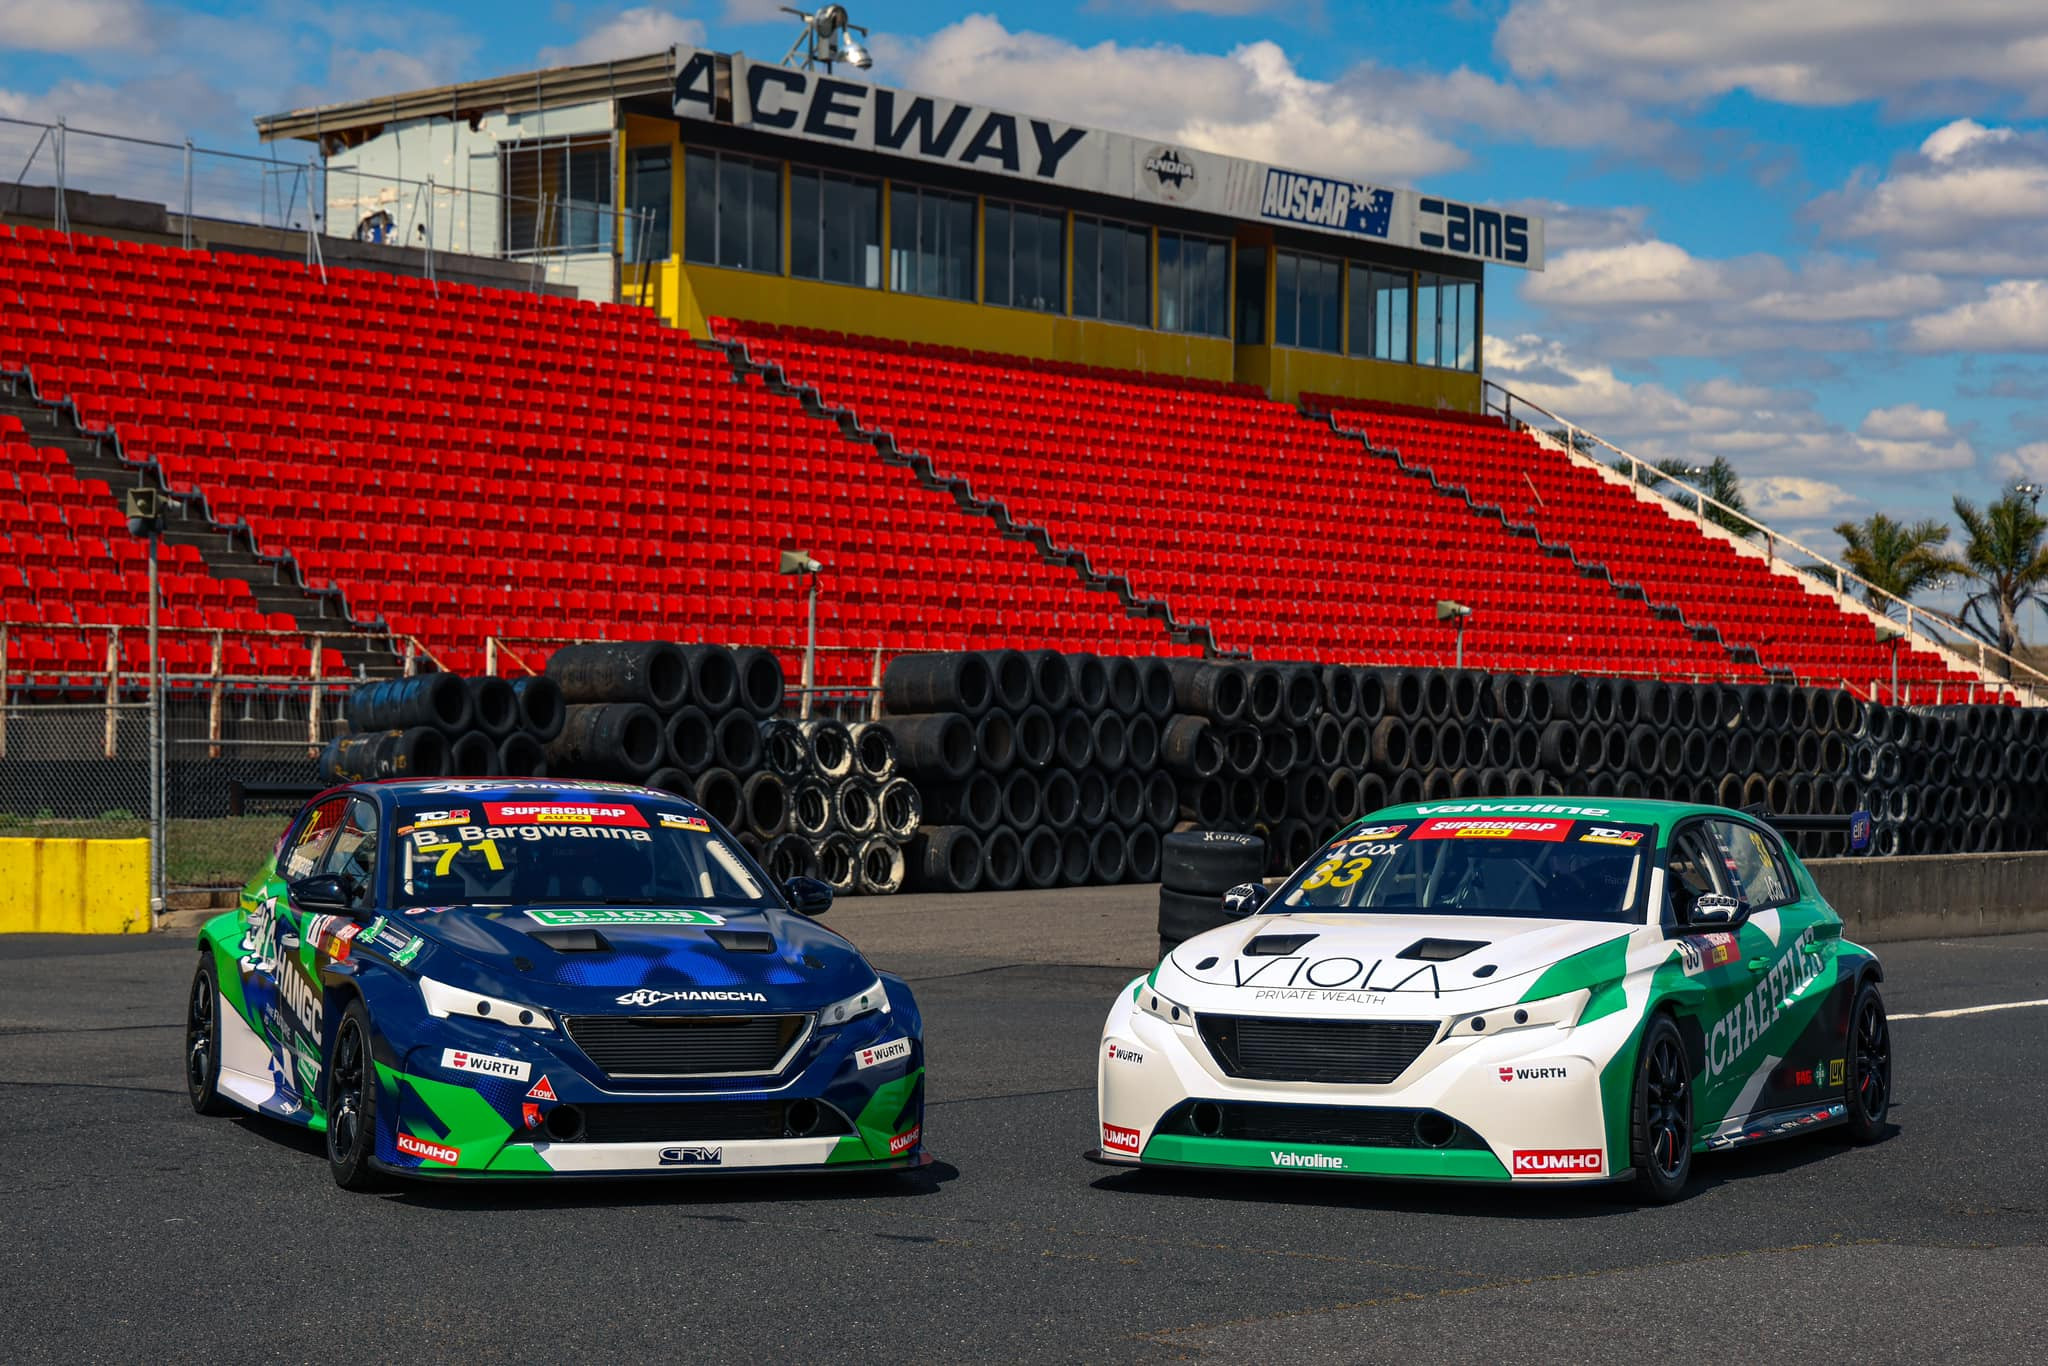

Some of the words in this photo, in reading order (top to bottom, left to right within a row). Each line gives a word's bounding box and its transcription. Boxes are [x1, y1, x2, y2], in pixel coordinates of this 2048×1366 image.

[1263, 170, 1350, 228] AUSCAR
[415, 809, 471, 822] TCR
[501, 806, 626, 818] SUPERCHEAP
[1416, 804, 1610, 817] Valvoline
[657, 812, 708, 827] TCR
[1430, 821, 1557, 832] SUPERCHEAP
[413, 830, 450, 847] B.
[458, 825, 653, 842] Bargwanna
[1589, 827, 1644, 841] TCR
[1349, 842, 1403, 857] Cox
[418, 839, 504, 877] 71
[1301, 857, 1373, 890] 33
[542, 911, 696, 919] LI-ION
[1234, 957, 1440, 999] VIOLA
[673, 991, 768, 1002] HANGCHA
[1255, 990, 1316, 1001] PRIVATE
[1322, 991, 1386, 1006] WEALTH
[533, 1089, 552, 1098] TOW
[398, 1136, 458, 1163] KUMHO
[659, 1147, 722, 1163] GRM
[1270, 1151, 1343, 1168] Valvoline
[1516, 1154, 1600, 1169] KUMHO
